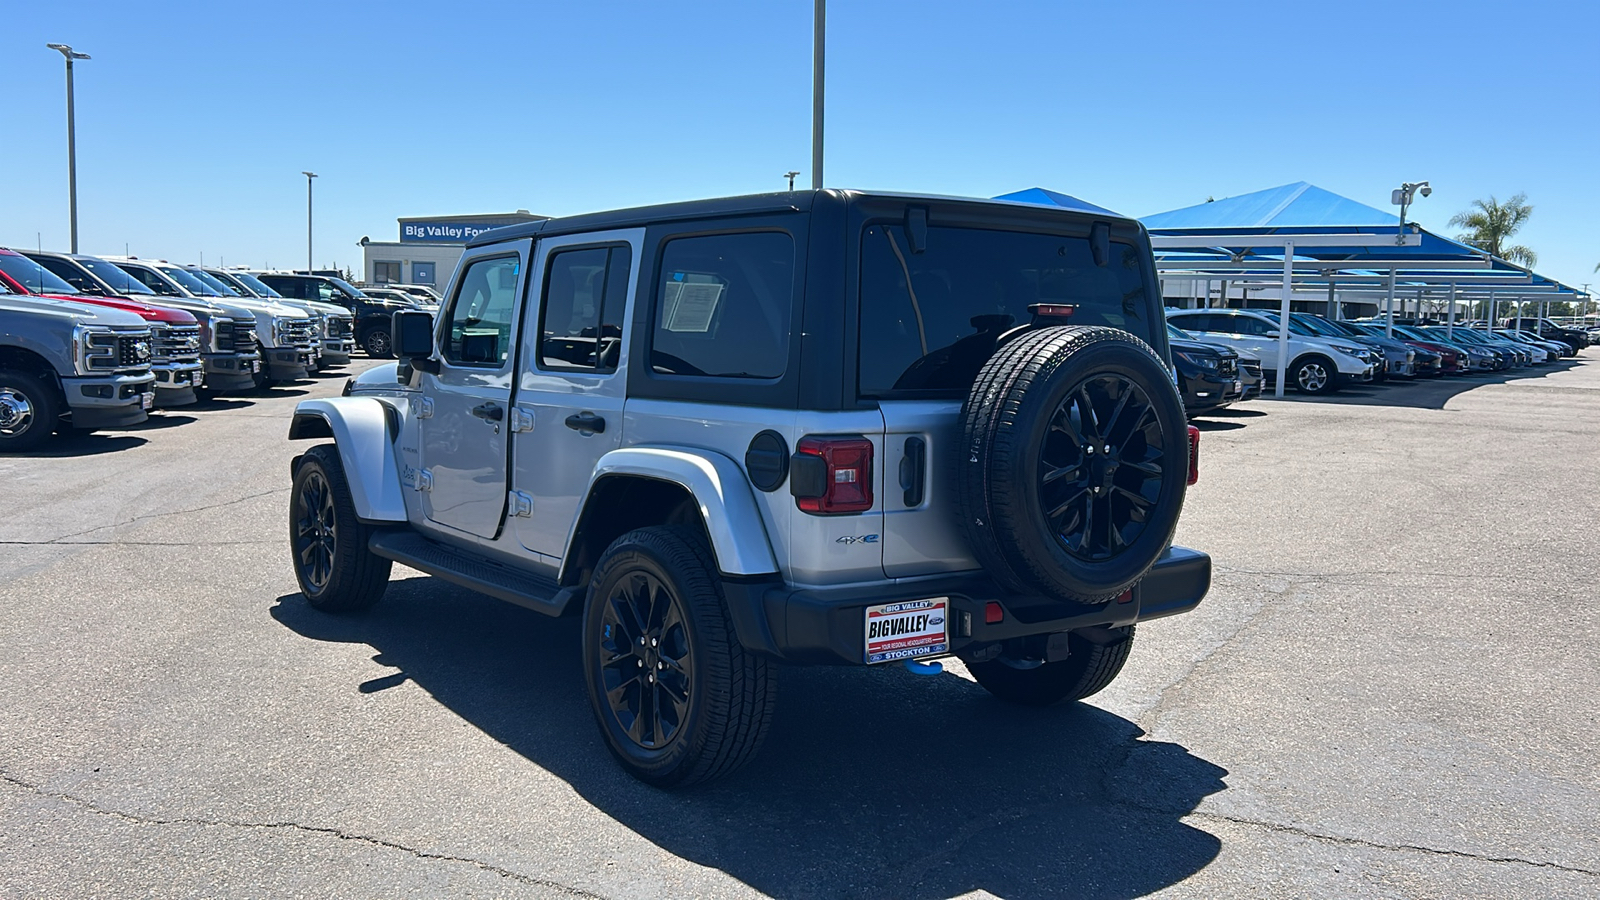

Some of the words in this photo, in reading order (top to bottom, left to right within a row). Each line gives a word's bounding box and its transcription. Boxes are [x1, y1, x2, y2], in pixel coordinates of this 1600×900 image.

[405, 226, 425, 238] Big
[426, 226, 462, 238] Valley
[465, 227, 490, 236] For
[901, 601, 929, 610] VALLEY
[868, 614, 930, 639] BIGVALLEY
[885, 646, 930, 659] STOCKTON
